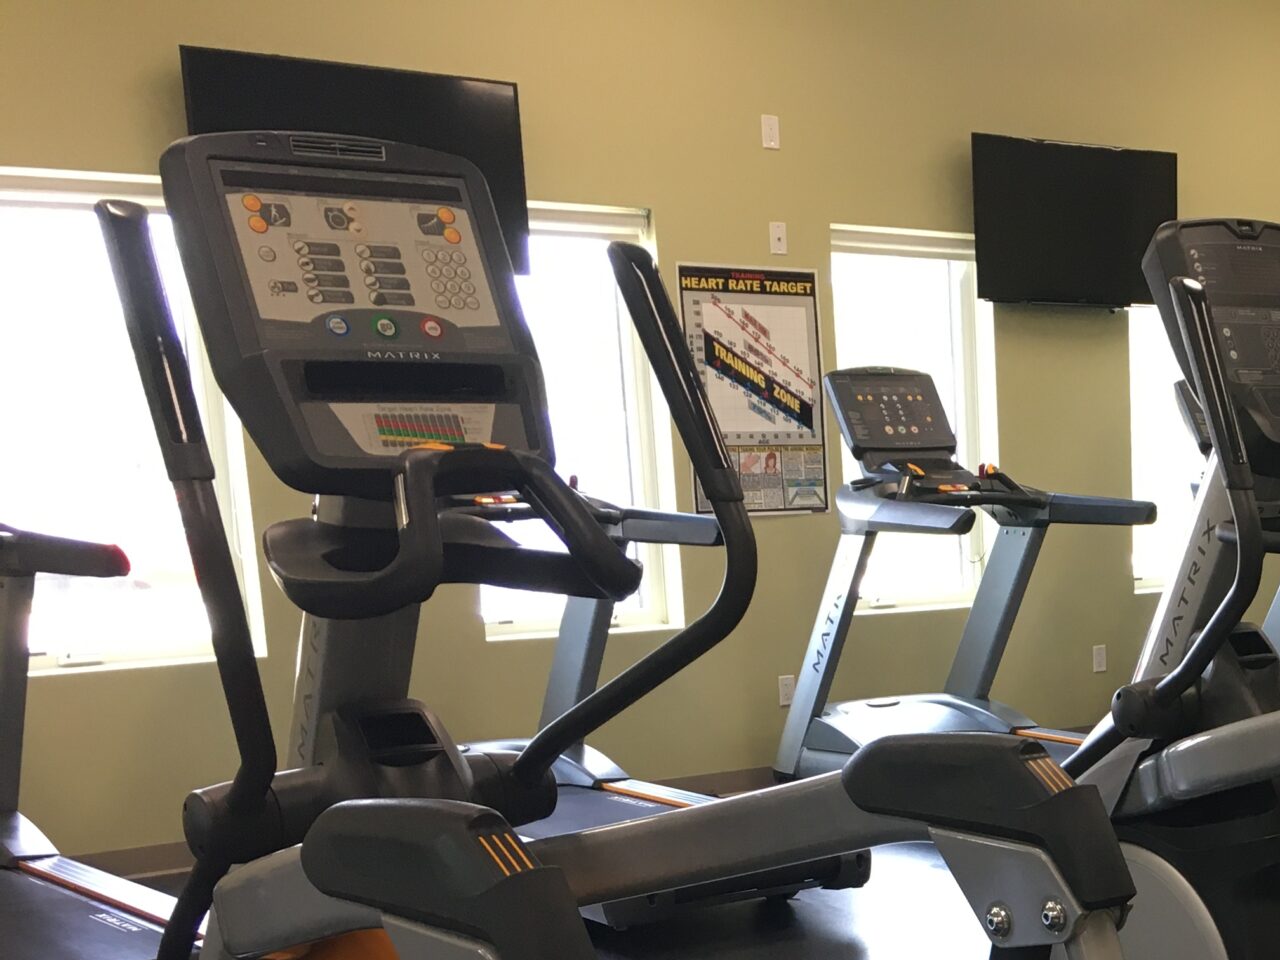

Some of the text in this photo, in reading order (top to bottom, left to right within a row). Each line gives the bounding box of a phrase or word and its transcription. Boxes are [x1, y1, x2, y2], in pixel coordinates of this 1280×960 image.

[681, 277, 812, 294] HEART RATE TARGET
[367, 351, 441, 360] MATRIX
[713, 341, 766, 389] TRAINING
[772, 382, 801, 413] ZONE
[1159, 517, 1217, 666] MATRIX
